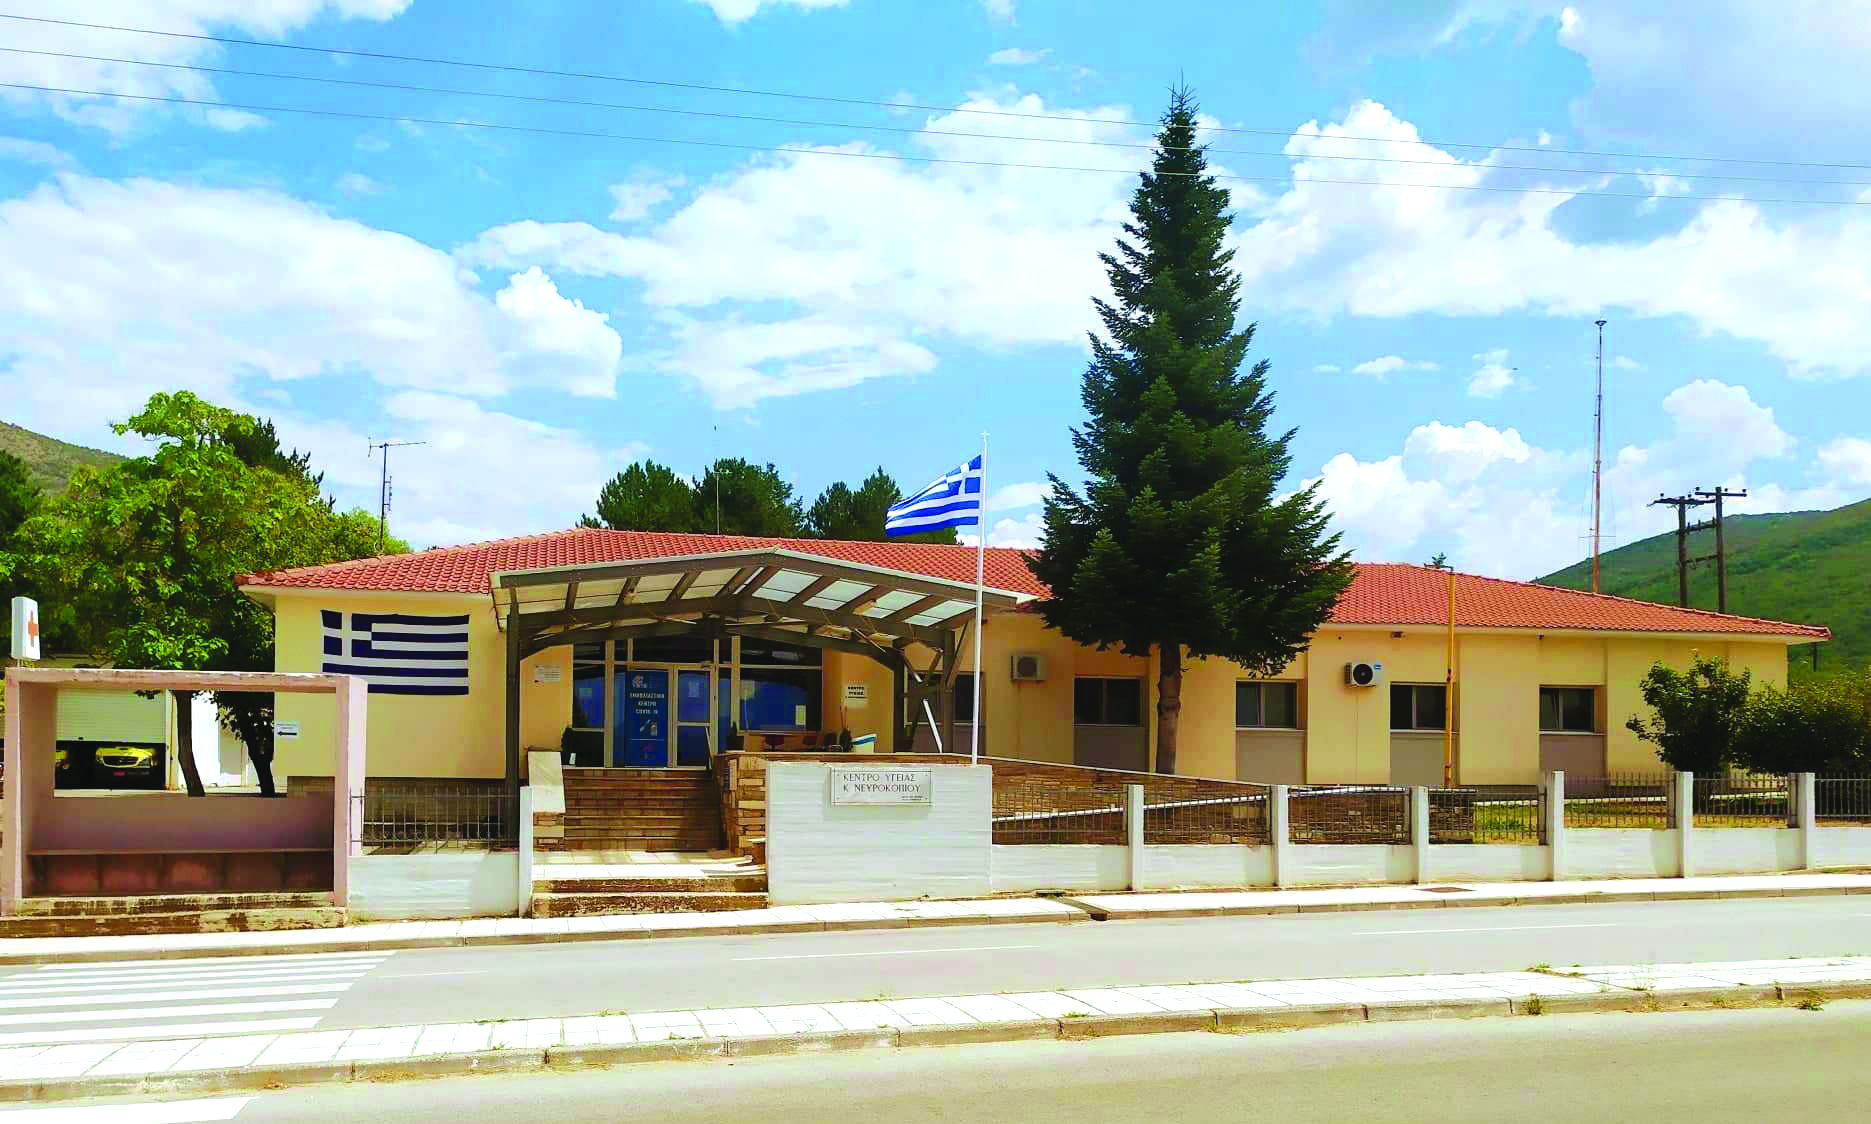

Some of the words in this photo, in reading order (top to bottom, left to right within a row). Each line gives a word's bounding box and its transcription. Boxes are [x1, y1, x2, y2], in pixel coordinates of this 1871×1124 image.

[843, 773, 880, 782] ΚΕΝΤΡΟ
[885, 773, 916, 782] ΥΓΕΙΑΣ
[855, 784, 920, 793] ΝΕΥΡΟΚΟΠΙΟΥ
